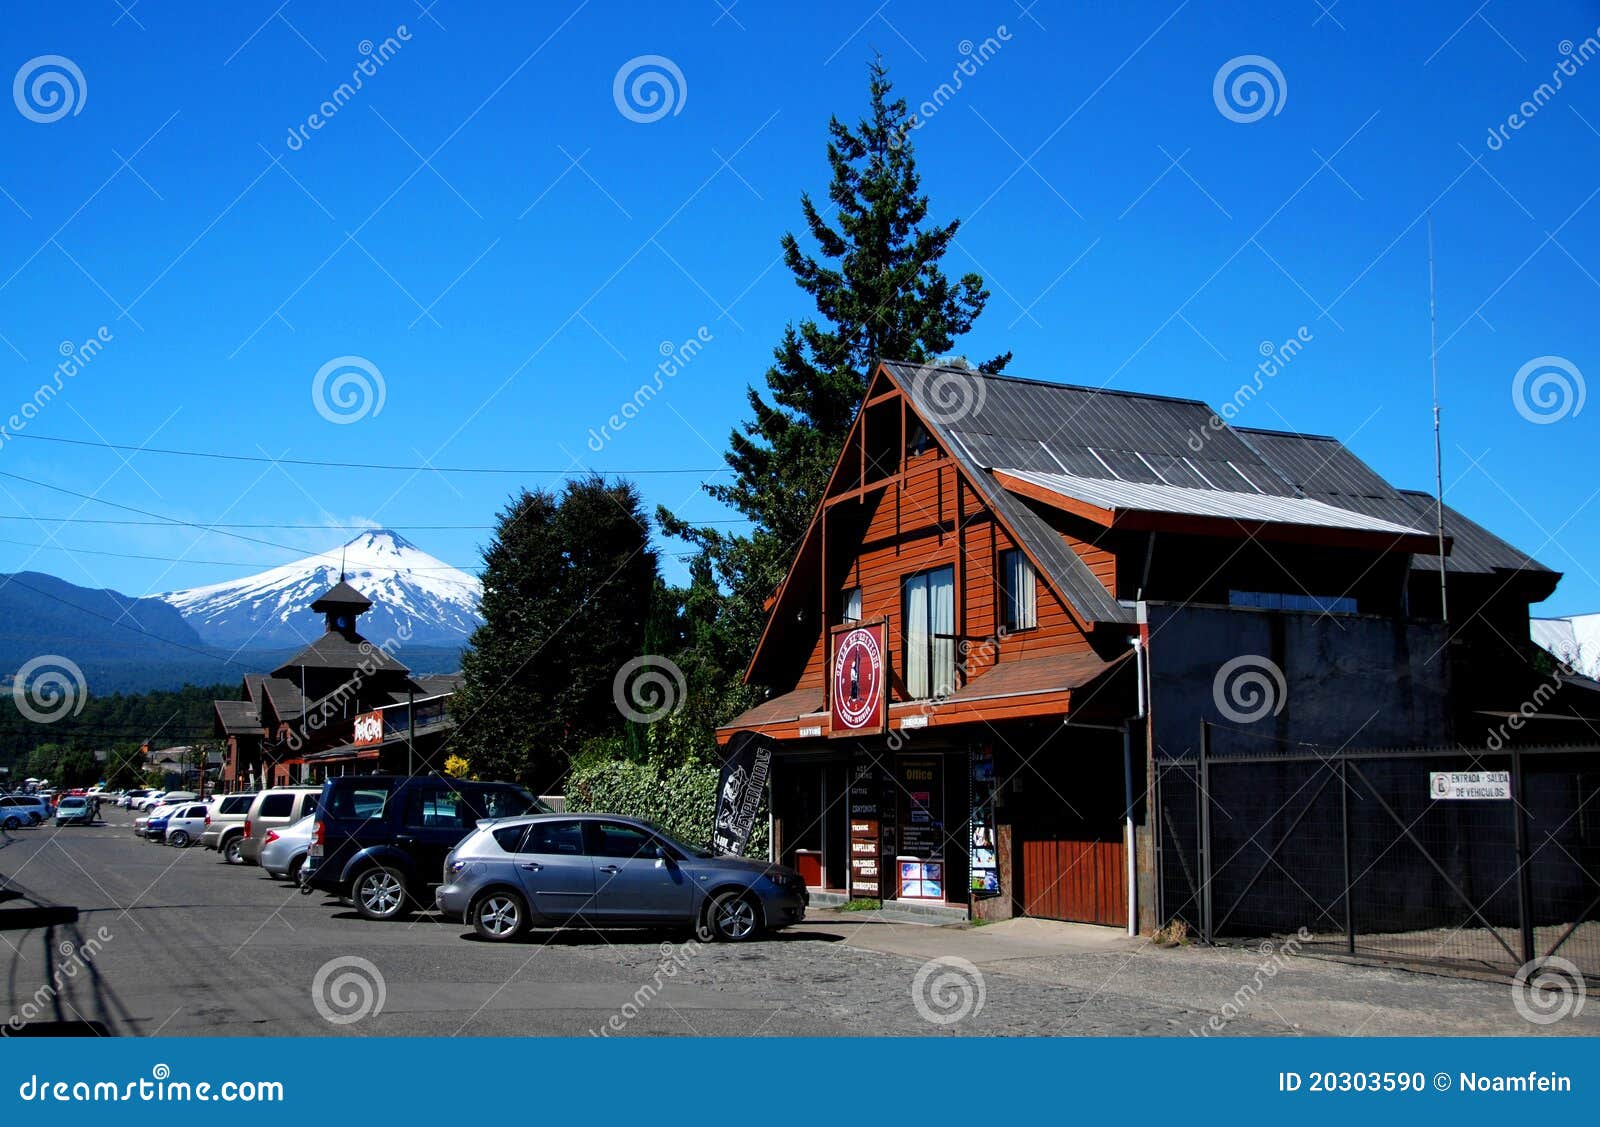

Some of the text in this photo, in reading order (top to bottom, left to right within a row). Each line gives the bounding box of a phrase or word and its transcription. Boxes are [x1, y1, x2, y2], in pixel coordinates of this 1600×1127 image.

[1451, 774, 1480, 783] ENTRADA
[1486, 773, 1509, 782] SALIDA
[737, 747, 772, 832] EXPEDITIONS
[1456, 788, 1505, 797] DE VEHICULOS
